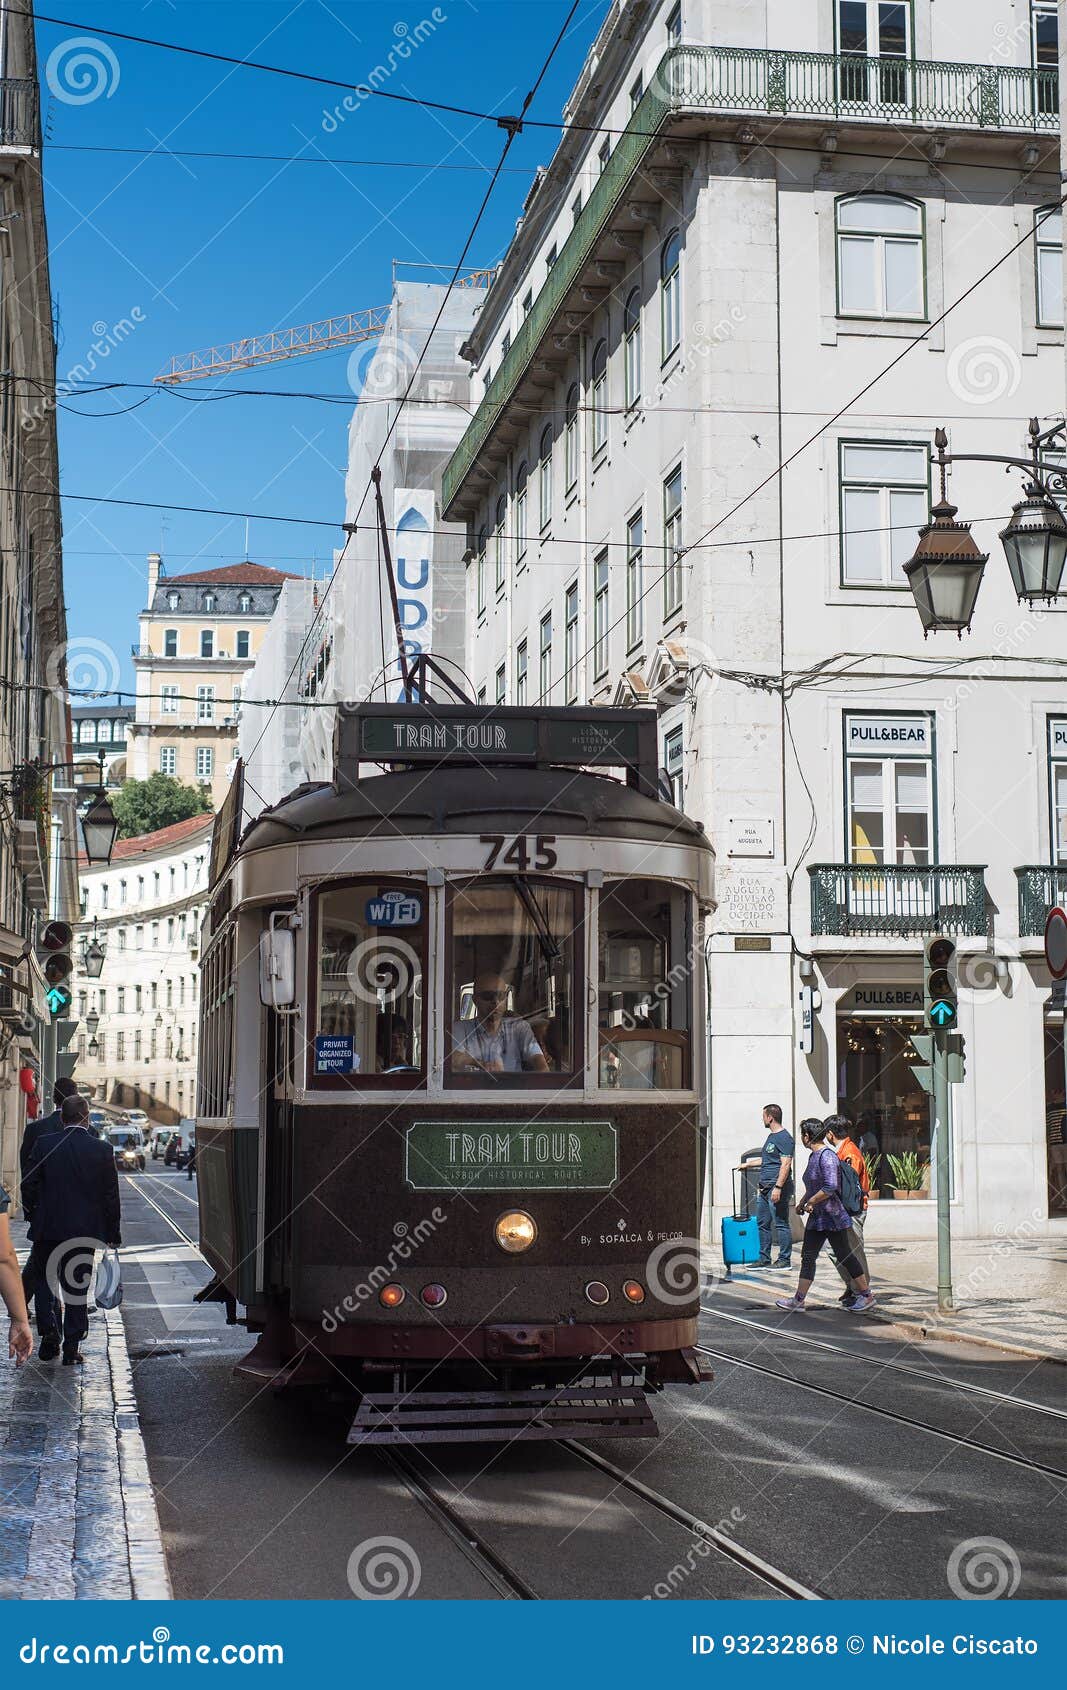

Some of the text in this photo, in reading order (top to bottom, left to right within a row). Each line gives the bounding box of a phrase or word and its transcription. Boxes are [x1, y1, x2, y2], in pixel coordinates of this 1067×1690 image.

[394, 724, 507, 749] TRAM TOUR
[851, 727, 925, 741] PULL&BEAR
[479, 835, 558, 871] 745
[855, 991, 924, 1003] PULL&BEA
[323, 1040, 348, 1048] PRIVATE
[319, 1049, 352, 1058] ORGANIZED
[445, 1133, 583, 1163] TRAM TOUR
[444, 1169, 583, 1180] LISBON HISTORICAL ROUTE
[580, 1235, 592, 1246] By
[599, 1233, 643, 1244] SOFALCA
[647, 1230, 654, 1242] &
